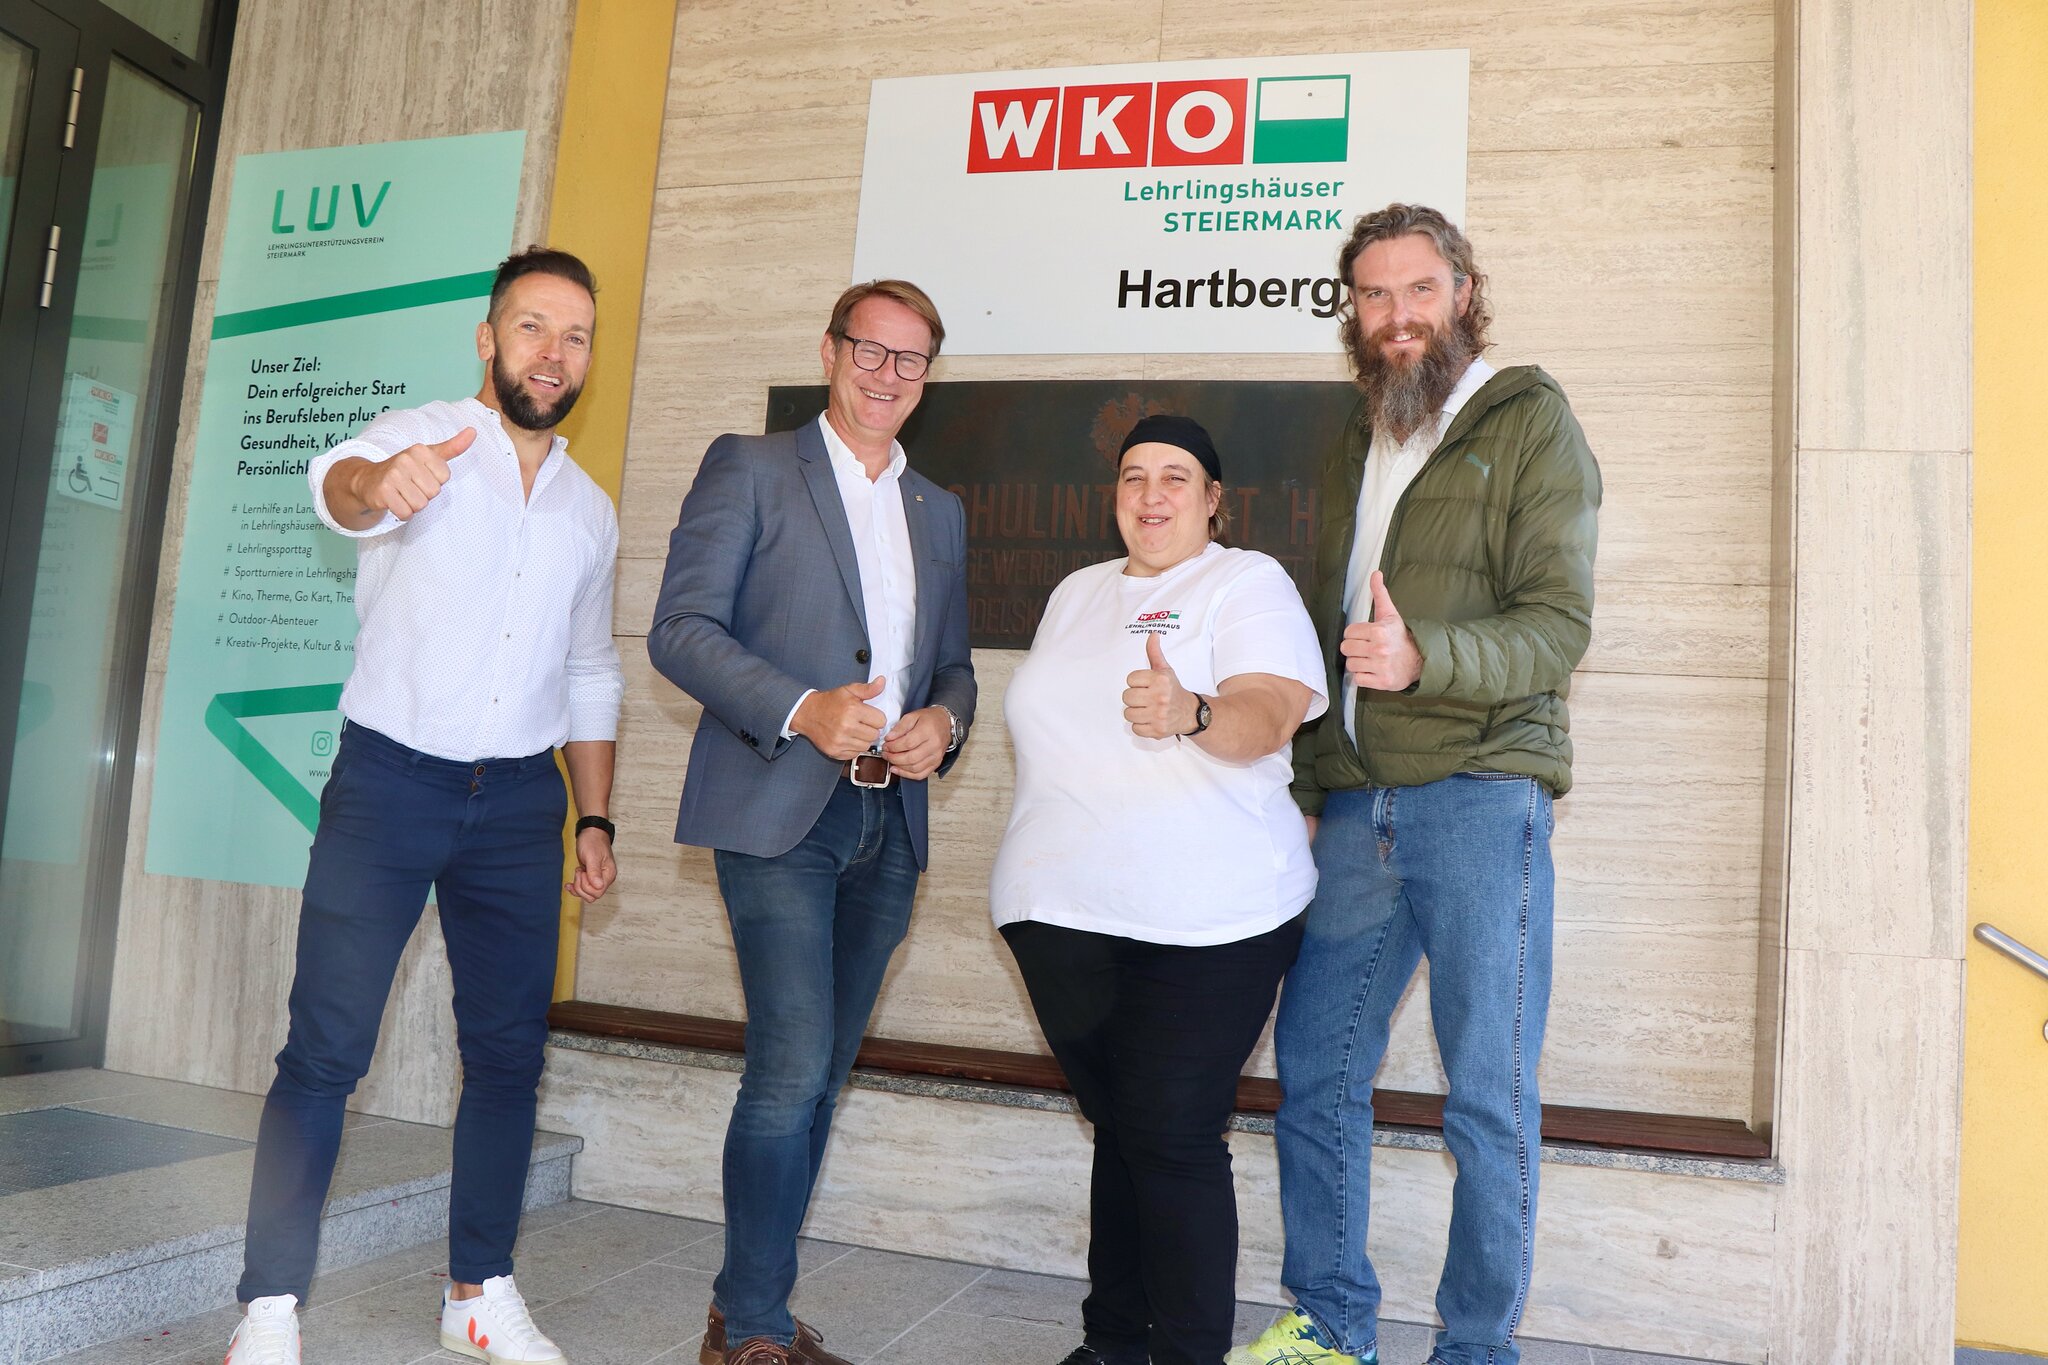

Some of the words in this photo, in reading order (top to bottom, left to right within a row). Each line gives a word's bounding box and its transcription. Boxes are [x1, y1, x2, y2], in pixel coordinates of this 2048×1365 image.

[978, 90, 1234, 160] WKO
[1124, 178, 1345, 204] Lehrlingshäuser
[272, 181, 392, 234] LUV
[1163, 209, 1343, 232] STEIERMARK
[268, 236, 385, 251] LEHRLINGSUNTERSTÜTZUNGSVEREIN
[267, 251, 306, 259] STEIERMARK
[1117, 268, 1341, 318] Hartberg
[251, 359, 290, 374] Unser
[292, 357, 321, 372] Ziel:
[248, 384, 278, 399] Dein
[282, 381, 368, 403] erfolgreicher
[371, 380, 406, 395] Start
[243, 410, 262, 424] ins
[266, 407, 344, 424] Berufsleben
[348, 406, 376, 428] plus
[240, 434, 320, 452] Gesundheit,
[242, 502, 281, 514] Lernhilfe
[283, 506, 294, 514] an
[240, 520, 249, 530] in
[251, 519, 325, 534] Lehrlingshäusern
[237, 543, 312, 558] Lehrlingssporttag
[234, 565, 293, 580] Sportturniere
[295, 567, 303, 577] in
[231, 589, 254, 602] Kino,
[257, 589, 292, 603] Therme,
[294, 590, 308, 602] Go
[311, 591, 333, 604] Kart,
[229, 612, 319, 626] Outdoor-Abenteuer
[1139, 611, 1169, 621] WKO
[1125, 622, 1180, 630] LEHRLINGSHAUS
[226, 636, 300, 653] Kreativ-Projekte,
[303, 639, 332, 651] Kultur
[333, 639, 342, 651] &
